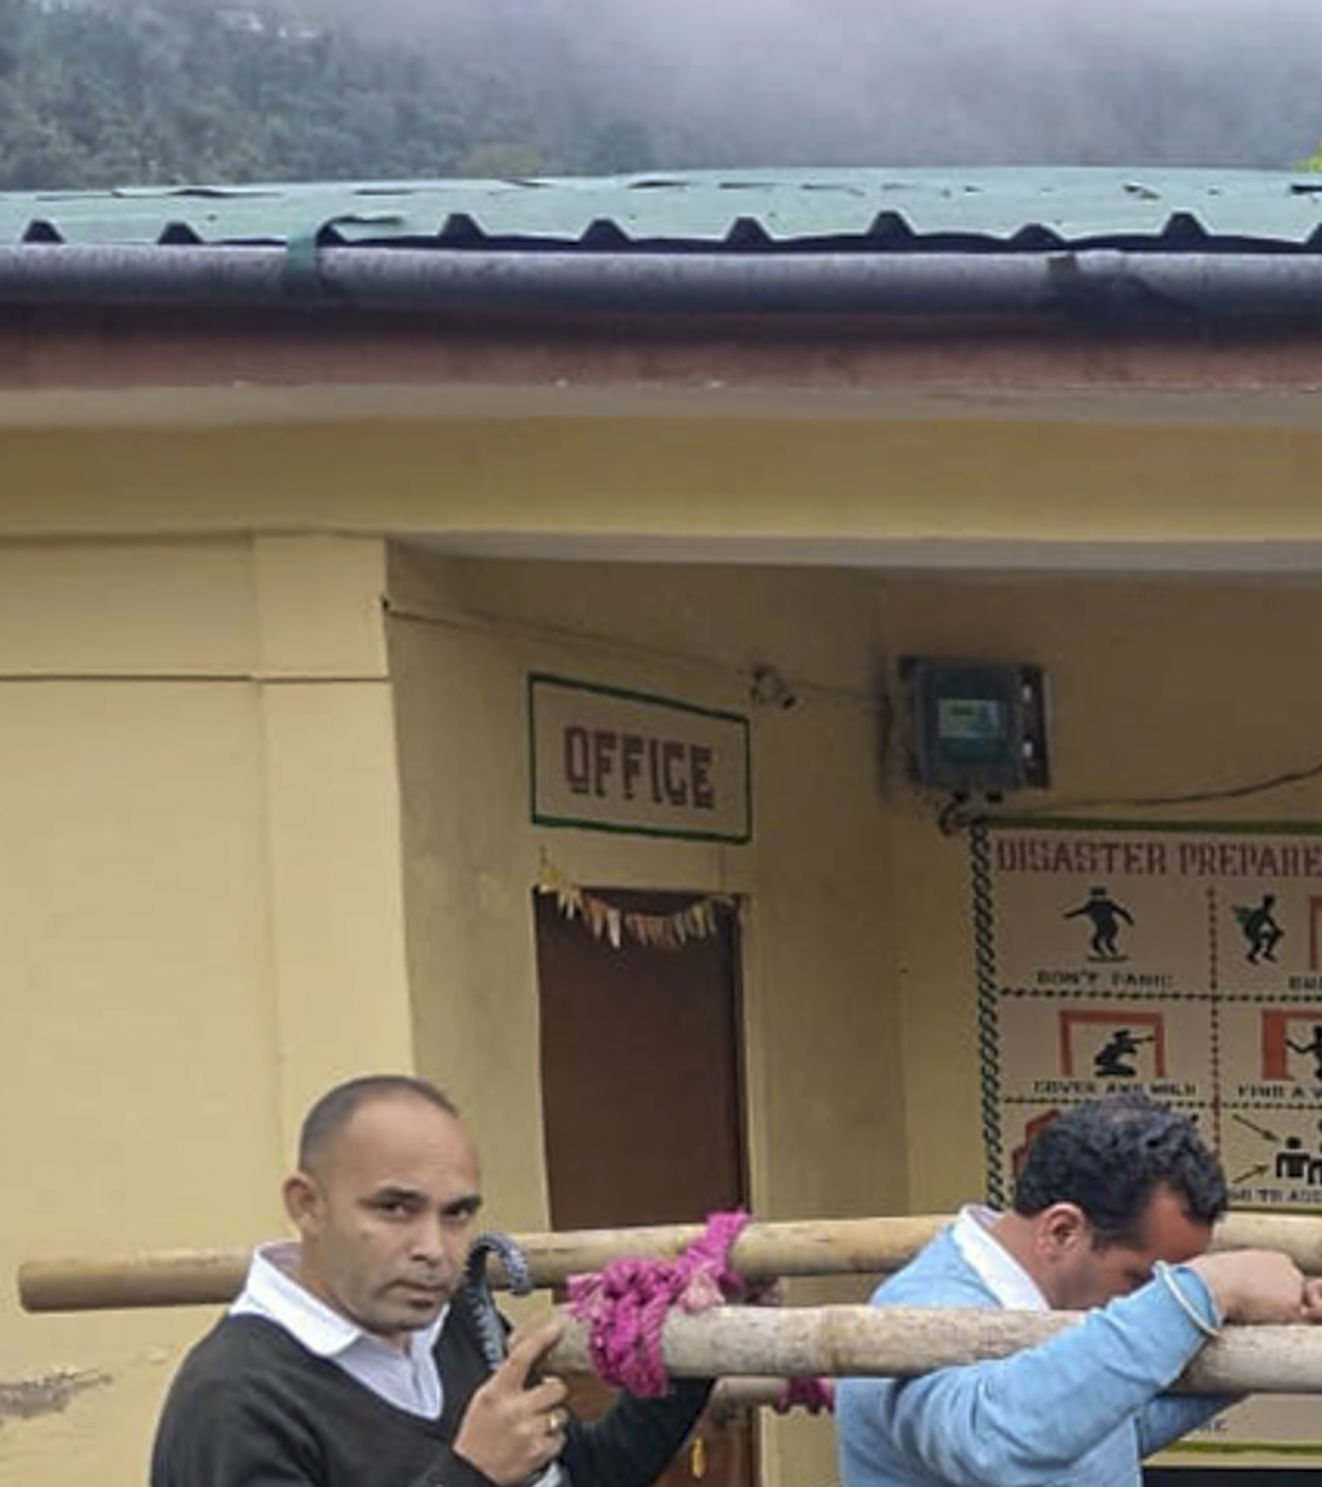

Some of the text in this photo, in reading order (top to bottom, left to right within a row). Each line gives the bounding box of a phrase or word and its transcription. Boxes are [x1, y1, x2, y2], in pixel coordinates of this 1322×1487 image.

[564, 725, 714, 810] OFFICE
[997, 838, 1167, 876] DISASTER
[1291, 1085, 1305, 1099] A
